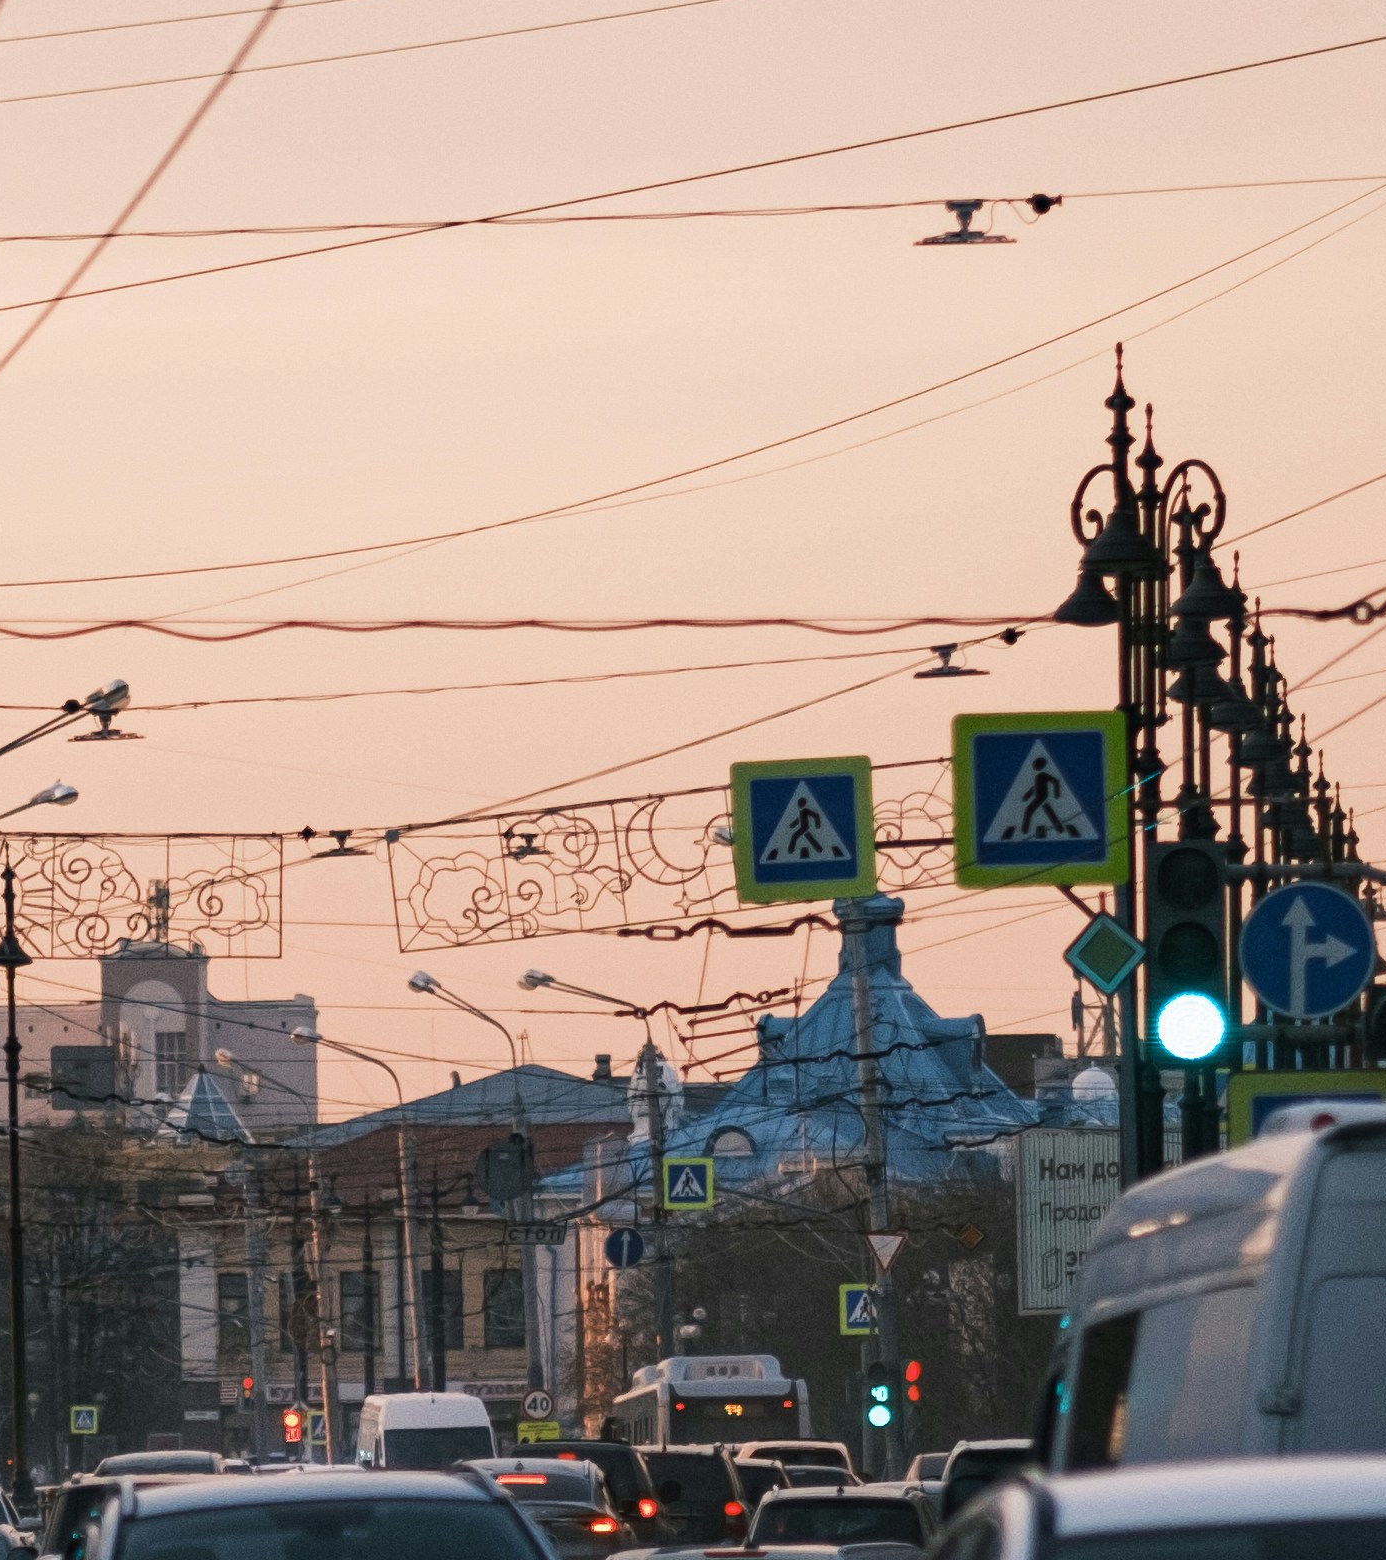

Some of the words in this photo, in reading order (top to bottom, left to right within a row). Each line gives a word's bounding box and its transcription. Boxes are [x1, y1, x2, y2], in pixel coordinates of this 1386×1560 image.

[1040, 1159, 1085, 1181] Нам
[1092, 1161, 1121, 1184] до
[1040, 1202, 1108, 1226] Прода
[508, 1228, 562, 1241] СТОП
[527, 1396, 550, 1412] 40
